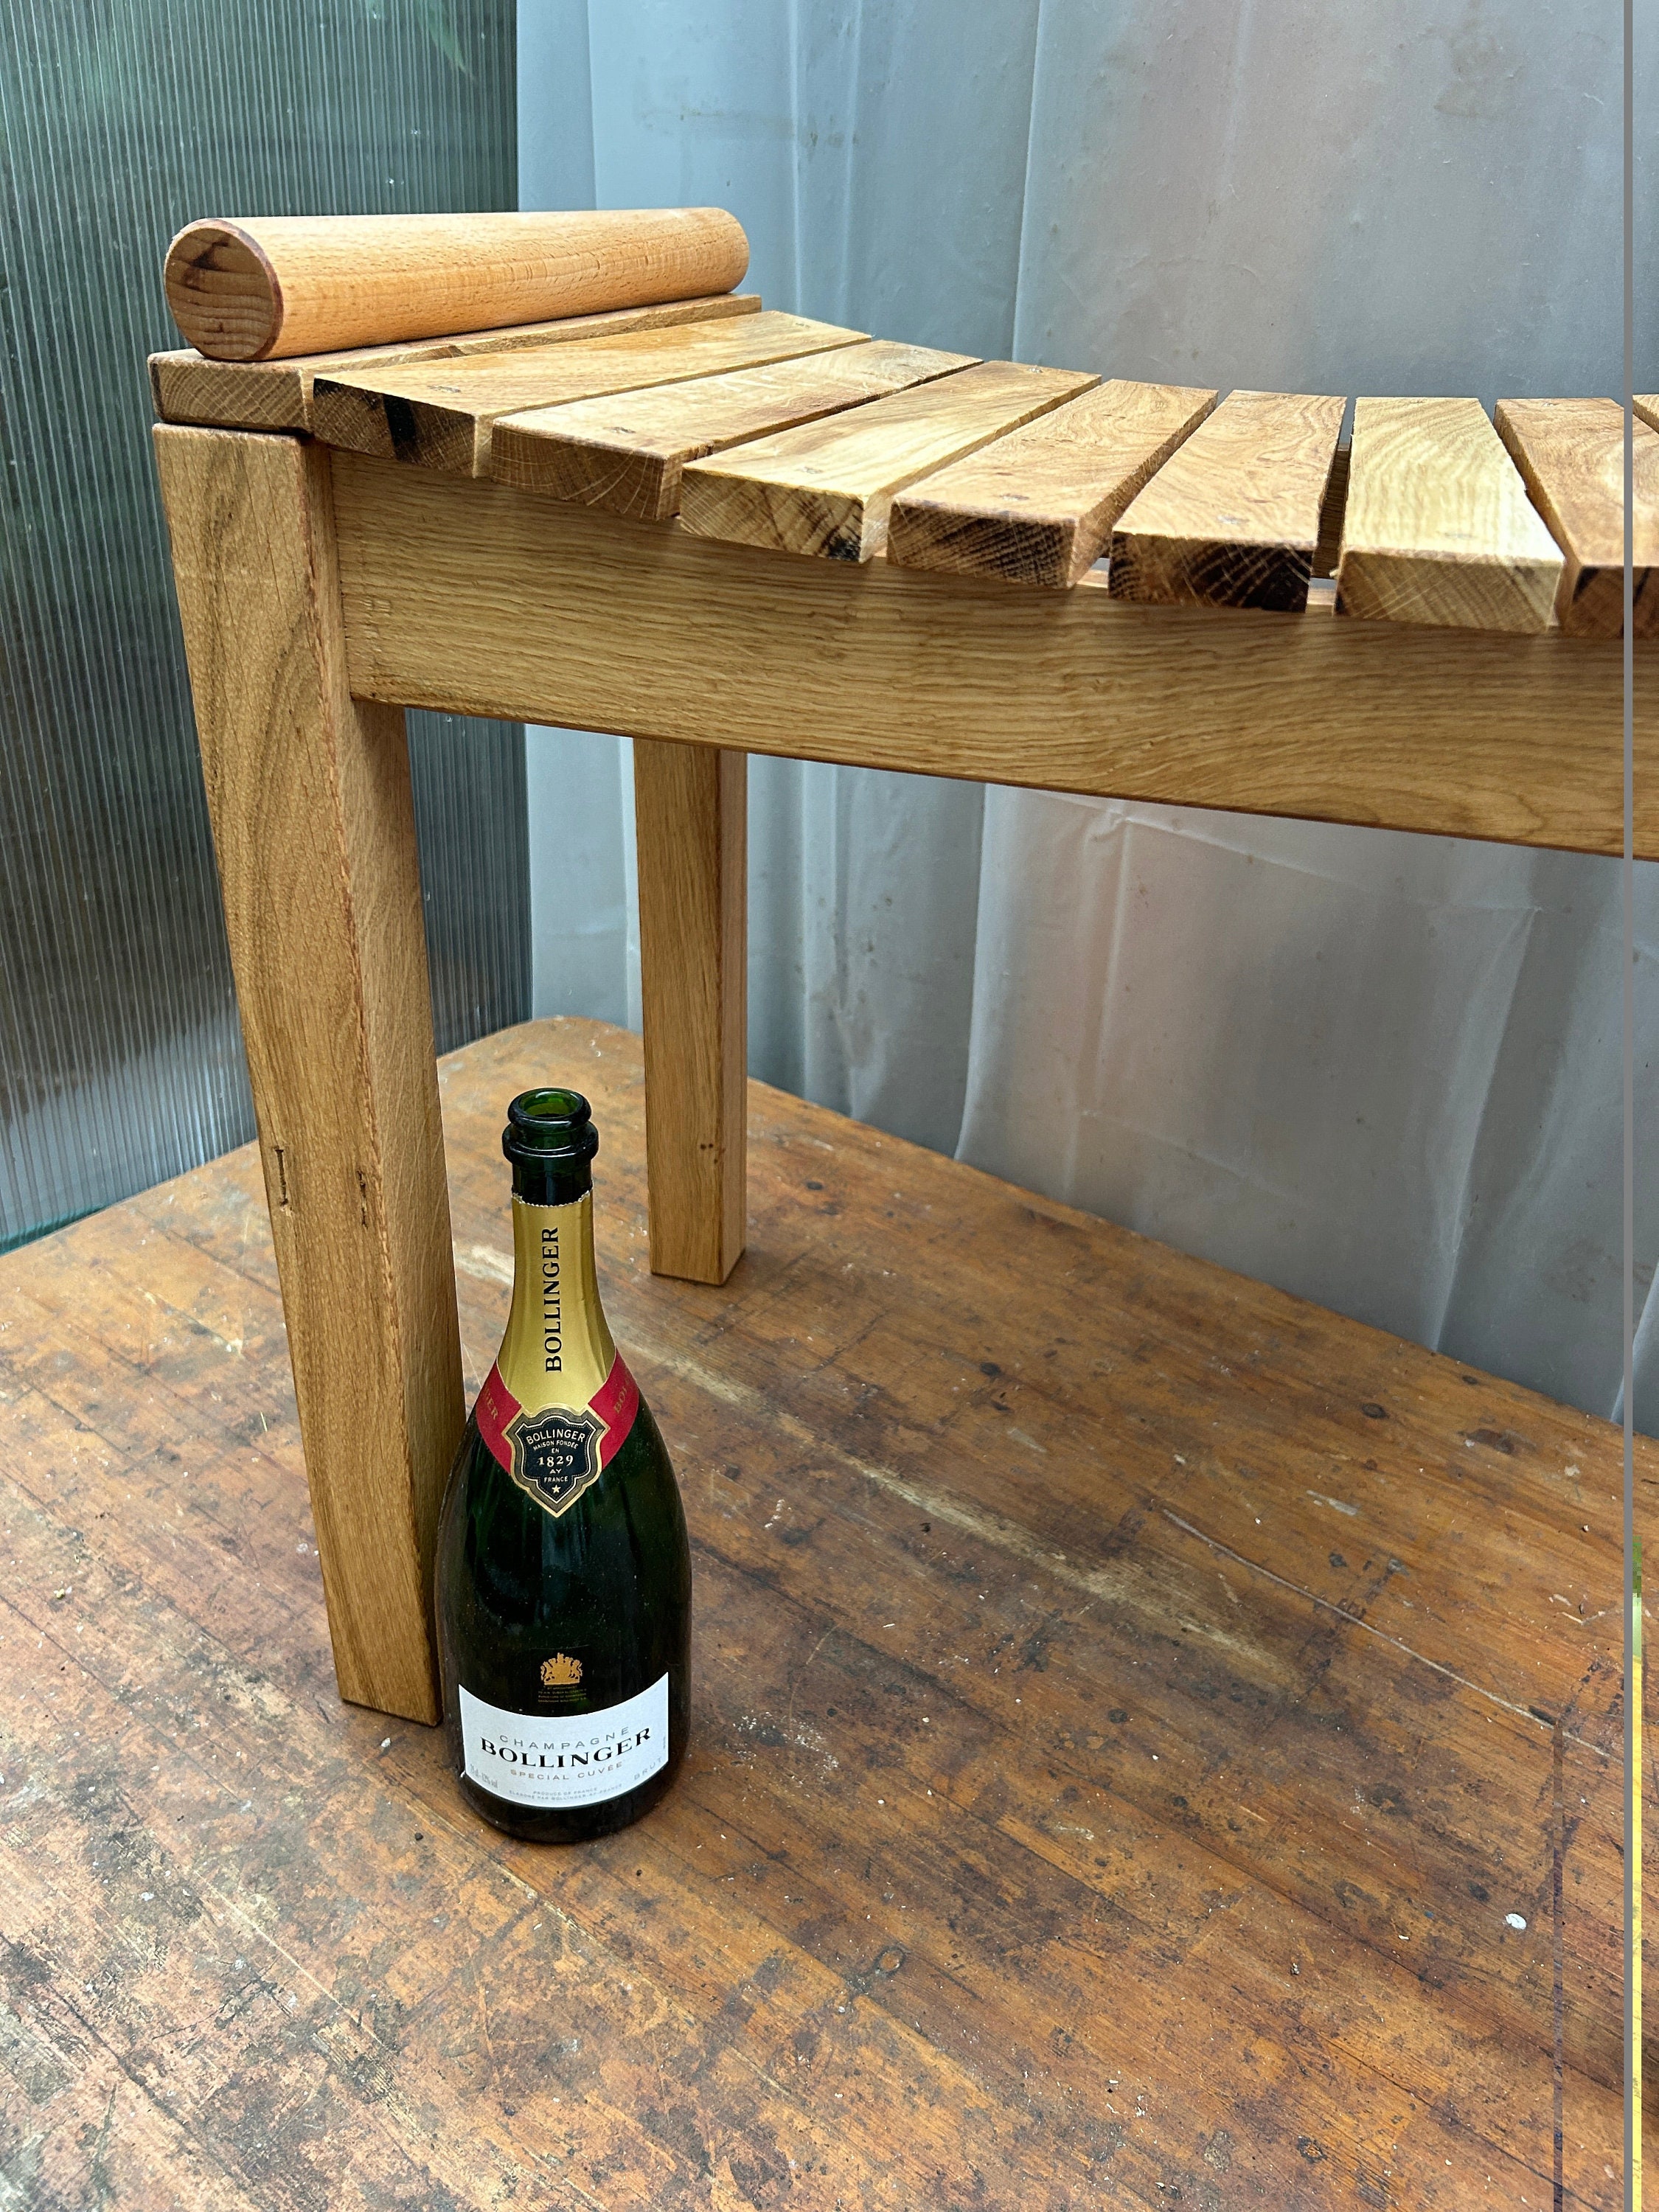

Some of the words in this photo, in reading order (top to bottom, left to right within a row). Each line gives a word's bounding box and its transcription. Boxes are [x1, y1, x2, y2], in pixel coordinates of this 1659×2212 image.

[541, 1226, 563, 1373] BOLLINGER
[526, 1428, 585, 1444] BOLLINGER
[532, 1440, 554, 1451] MAISON
[537, 1455, 574, 1467] 1829
[480, 1728, 651, 1768] BOLLINGER
[499, 1726, 629, 1750] CHAMPAGNE
[510, 1769, 570, 1781] SPECIAL
[634, 1756, 662, 1780] BRUT
